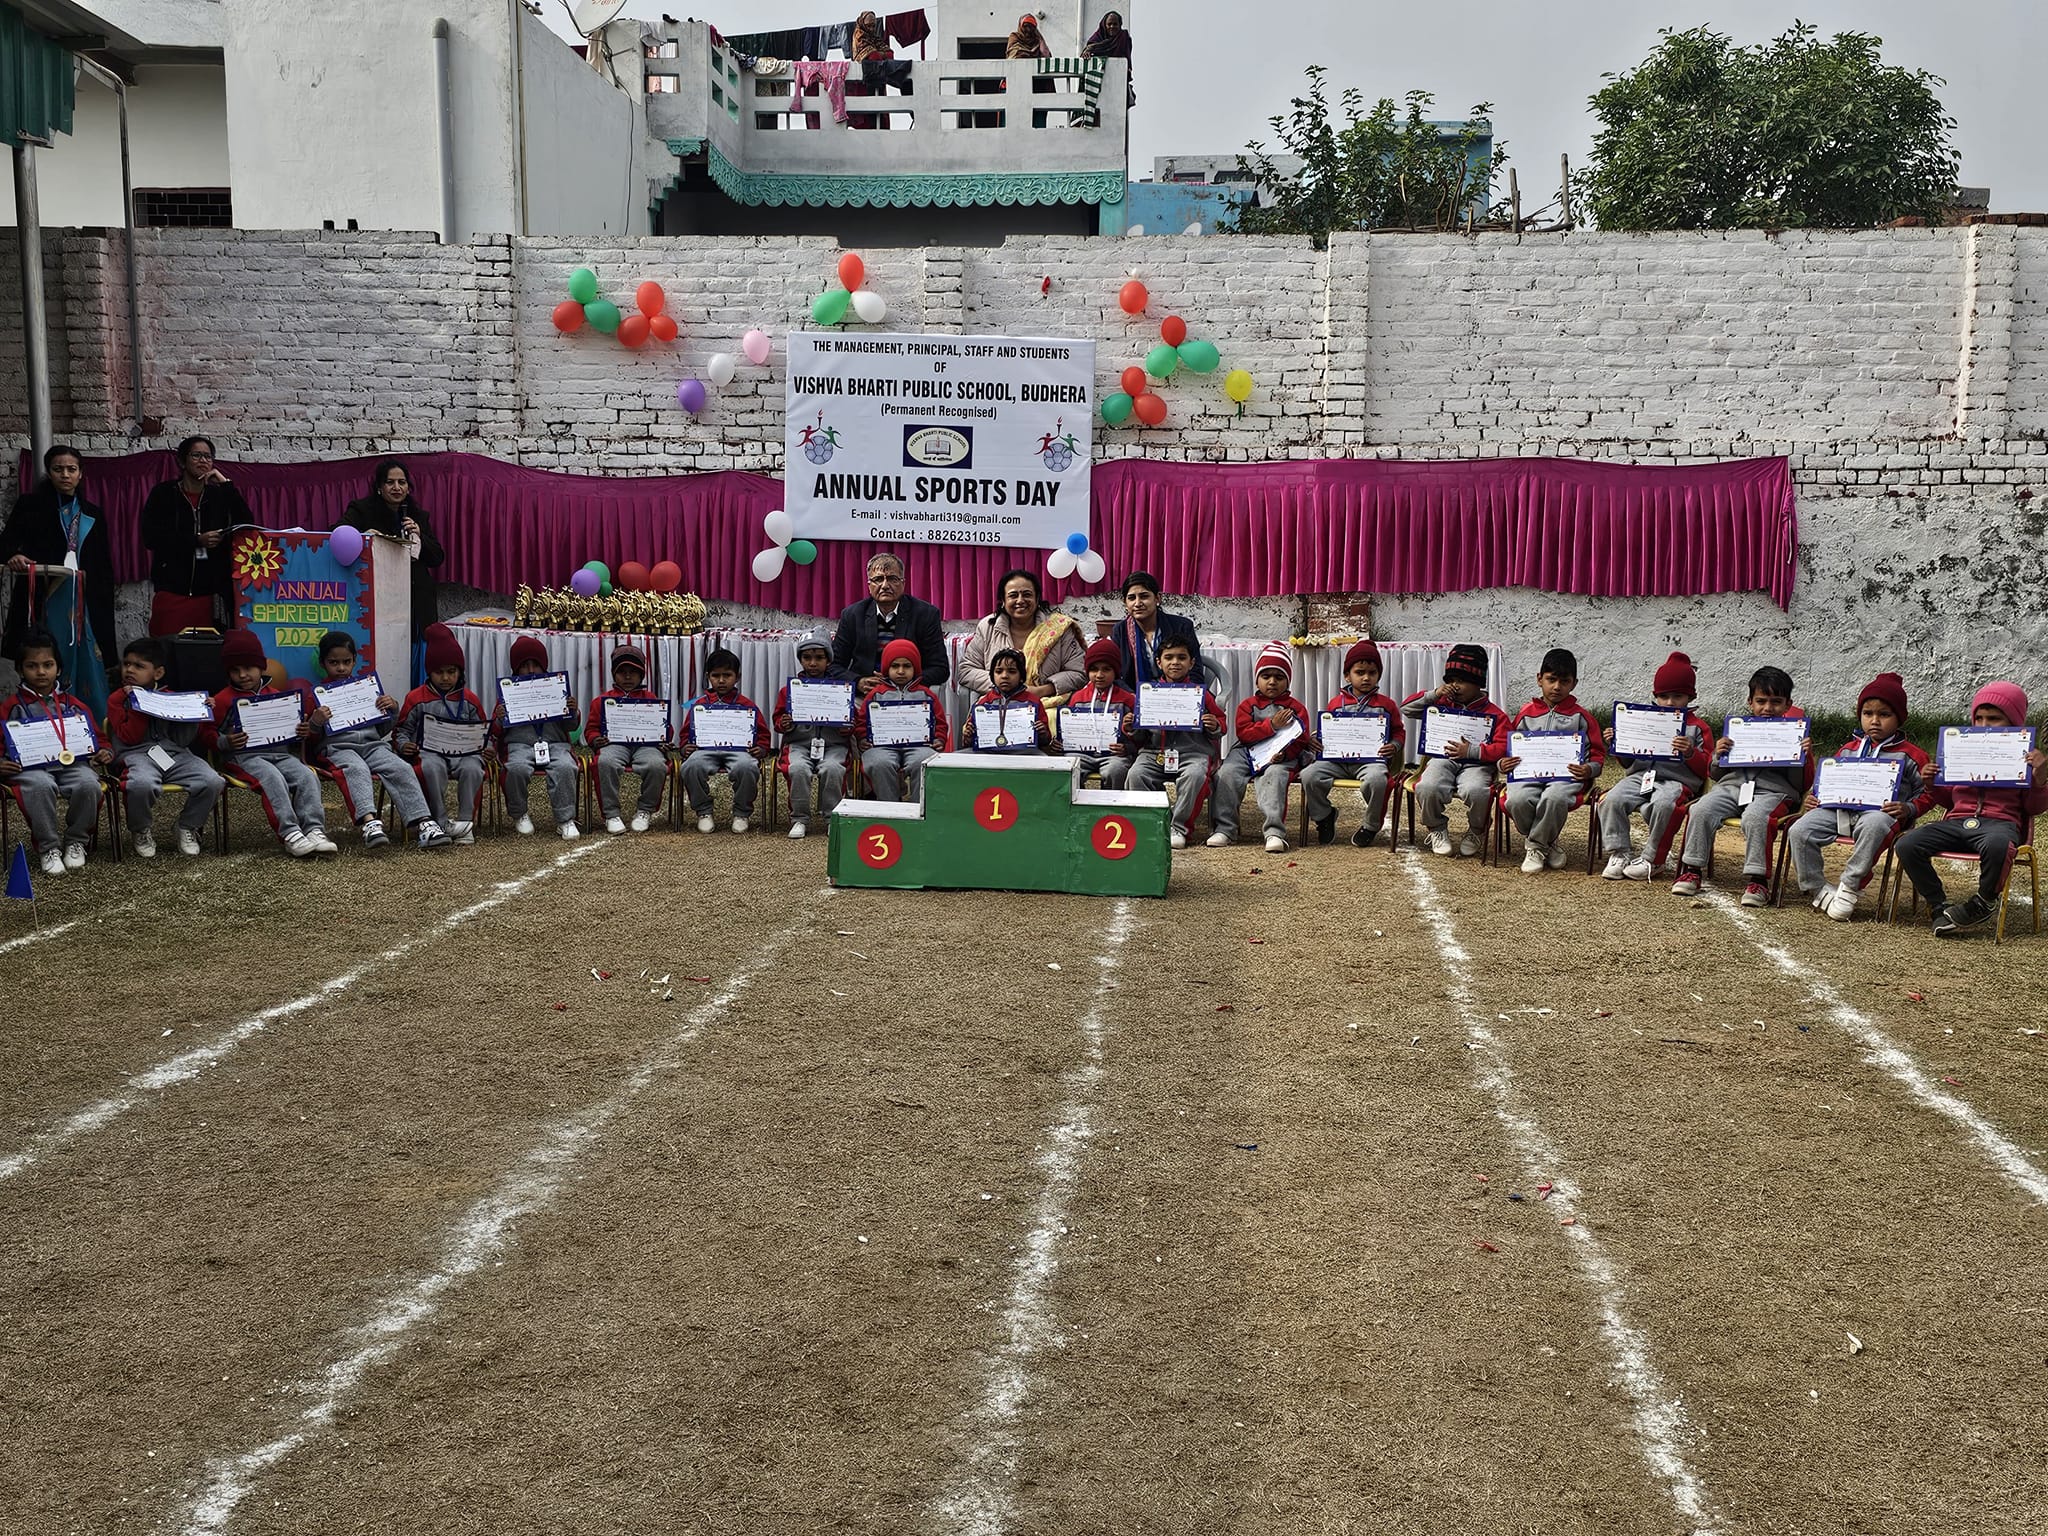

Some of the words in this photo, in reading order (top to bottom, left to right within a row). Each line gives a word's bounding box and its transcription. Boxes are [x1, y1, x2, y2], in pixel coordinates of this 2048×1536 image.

[813, 341, 831, 351] THE
[835, 341, 904, 356] MANAGEMENT,
[908, 344, 961, 358] PRINCIPAL,
[965, 345, 993, 356] STAFF
[997, 347, 1016, 357] AND
[1020, 347, 1069, 359] STUDENTS
[935, 362, 946, 372] OF
[794, 376, 842, 394] VISHVA
[848, 378, 897, 396] BHARTI
[903, 380, 952, 398] PUBLIC
[957, 382, 1016, 404] SCHOOL,
[1022, 384, 1086, 403] BUDHERA
[881, 403, 935, 416] (Permanent
[939, 405, 996, 420] Recognised)
[813, 473, 906, 501] ANNUAL
[915, 477, 1006, 505] SPORTS
[1016, 481, 1060, 506] DAY
[852, 509, 880, 519] E-mail
[890, 511, 1020, 525] vishvabharti319@gmail.com
[870, 528, 915, 540] Contact
[927, 530, 1000, 542] 8826231035
[276, 582, 346, 600] ANNUAL
[253, 604, 318, 623] SPORTS
[320, 605, 349, 622] DAY
[277, 628, 323, 646] 2023
[989, 794, 1002, 820] 1
[1104, 822, 1126, 849] 2
[868, 834, 889, 860] 3
